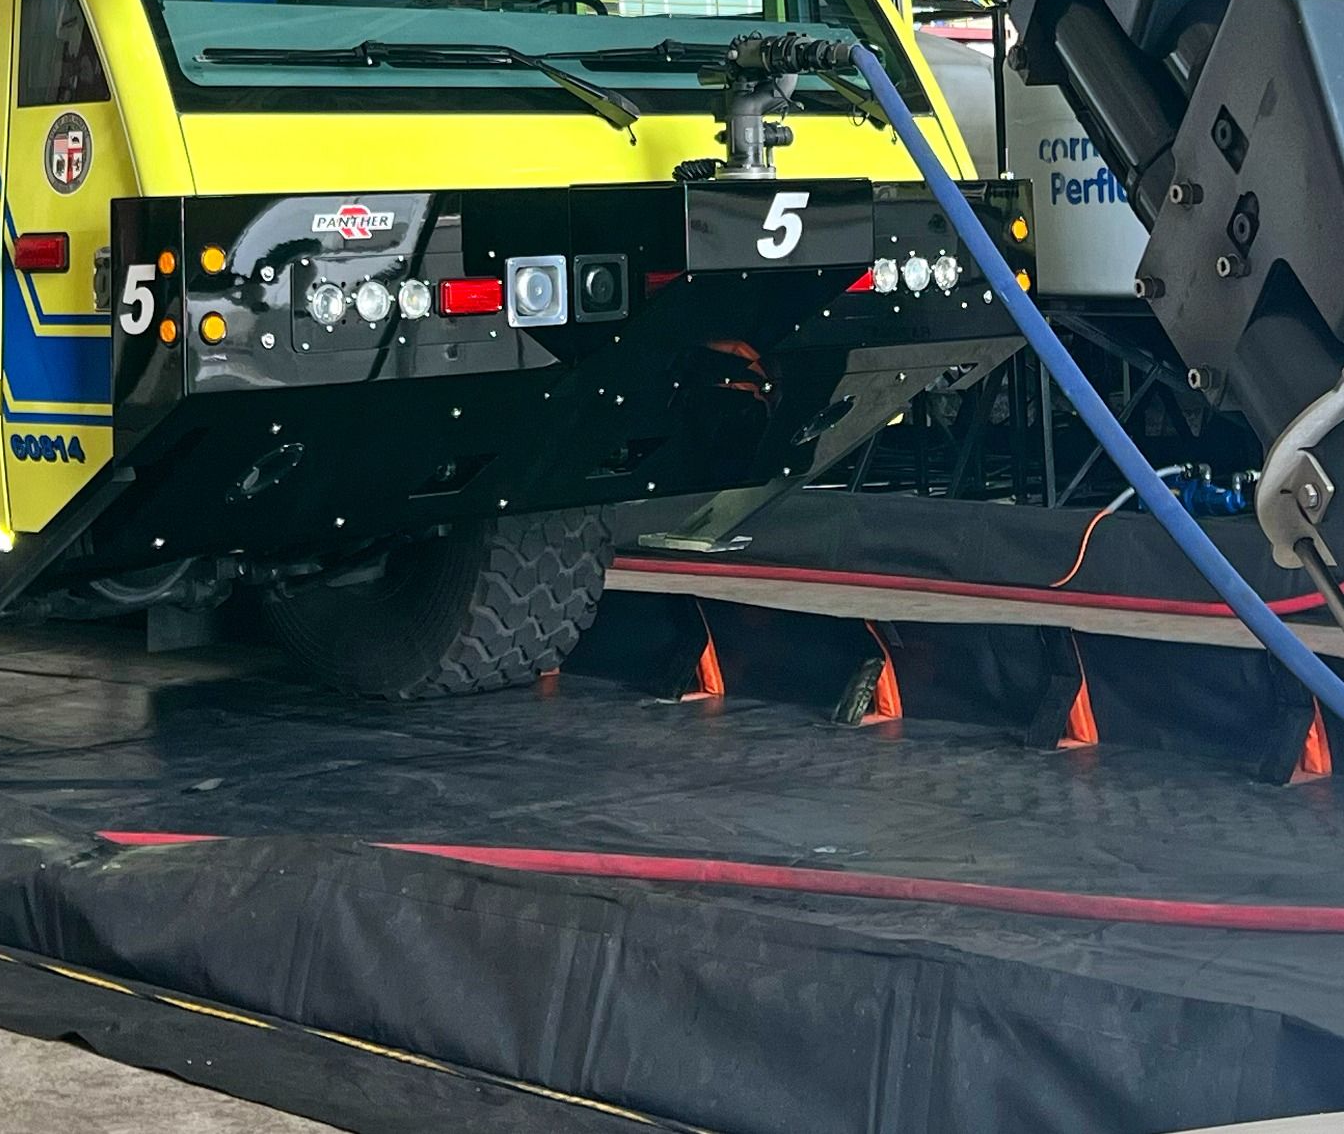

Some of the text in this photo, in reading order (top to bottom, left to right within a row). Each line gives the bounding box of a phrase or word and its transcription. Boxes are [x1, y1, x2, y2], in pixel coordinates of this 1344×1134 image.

[317, 215, 389, 229] PANTHER
[757, 192, 810, 259] 5
[119, 264, 156, 335] 5
